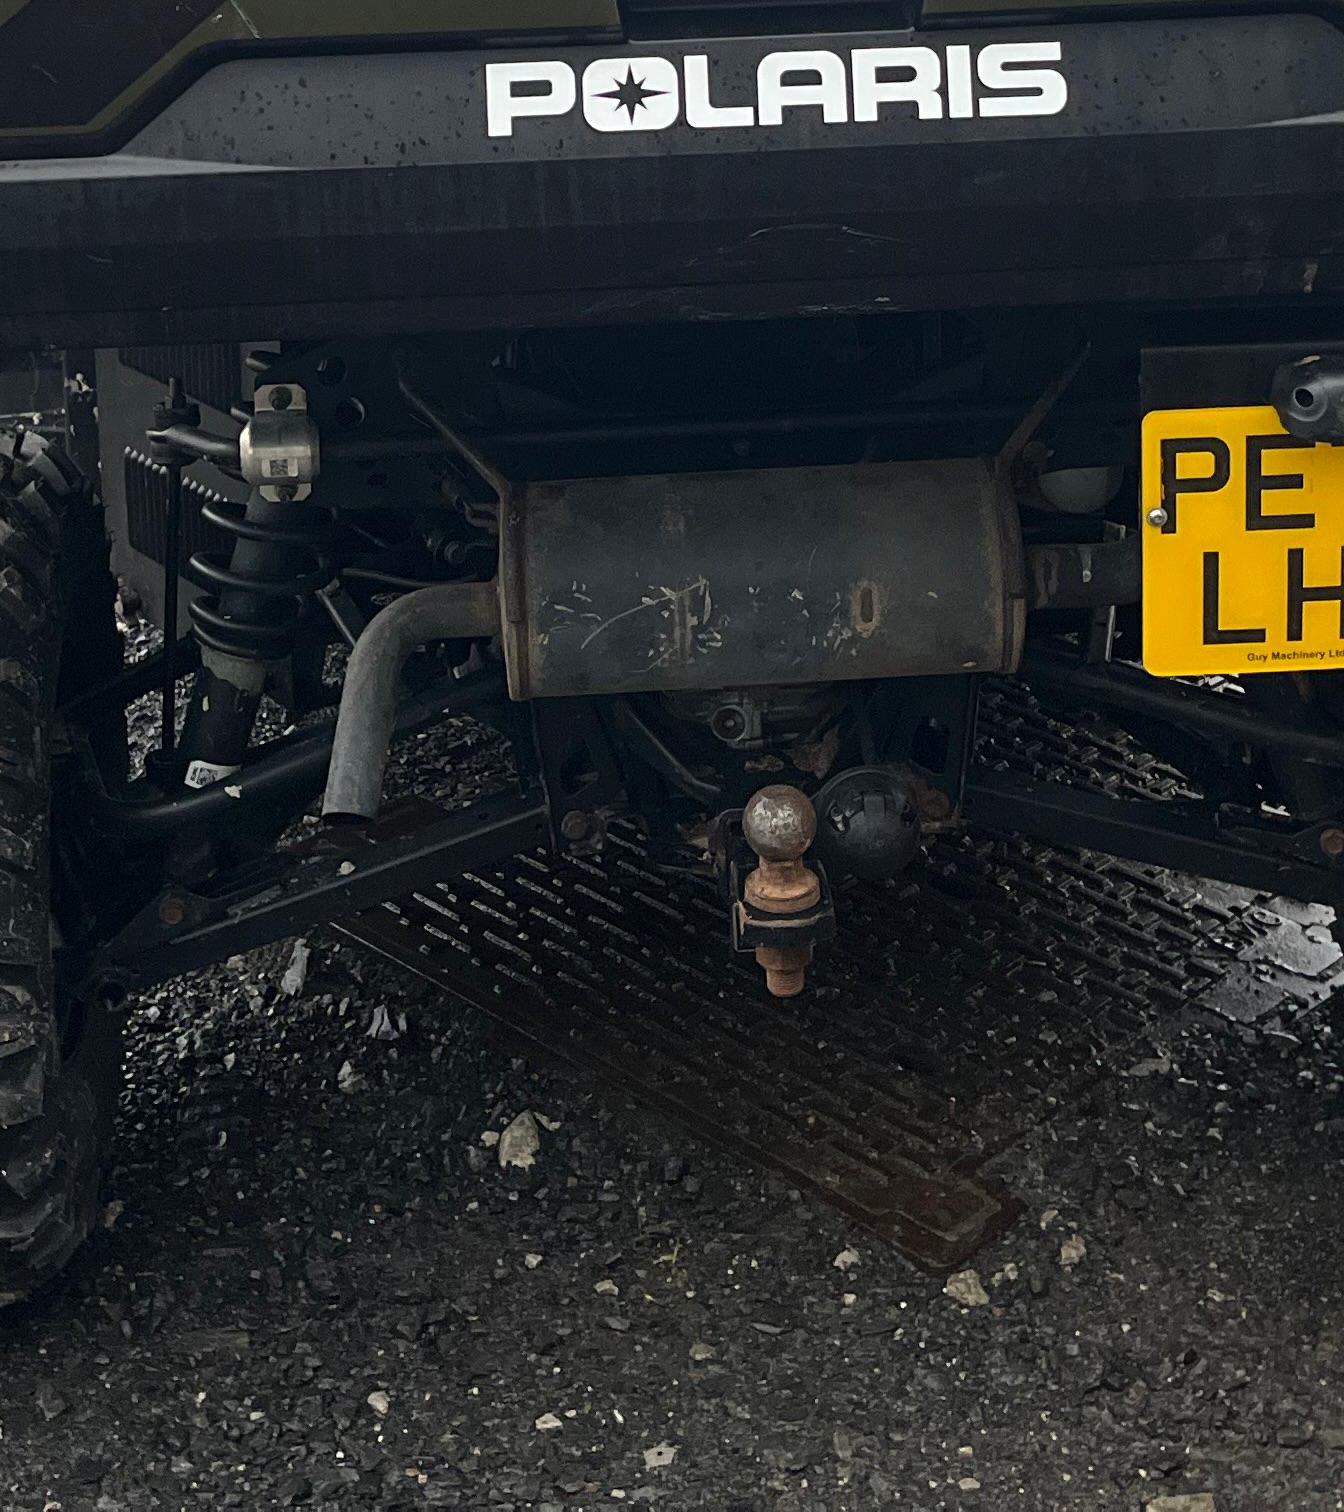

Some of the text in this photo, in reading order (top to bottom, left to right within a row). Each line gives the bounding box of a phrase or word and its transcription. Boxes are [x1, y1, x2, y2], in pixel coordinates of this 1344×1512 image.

[484, 40, 1068, 138] POLARIS
[1247, 652, 1268, 663] Guy
[1271, 648, 1325, 661] Machinery
